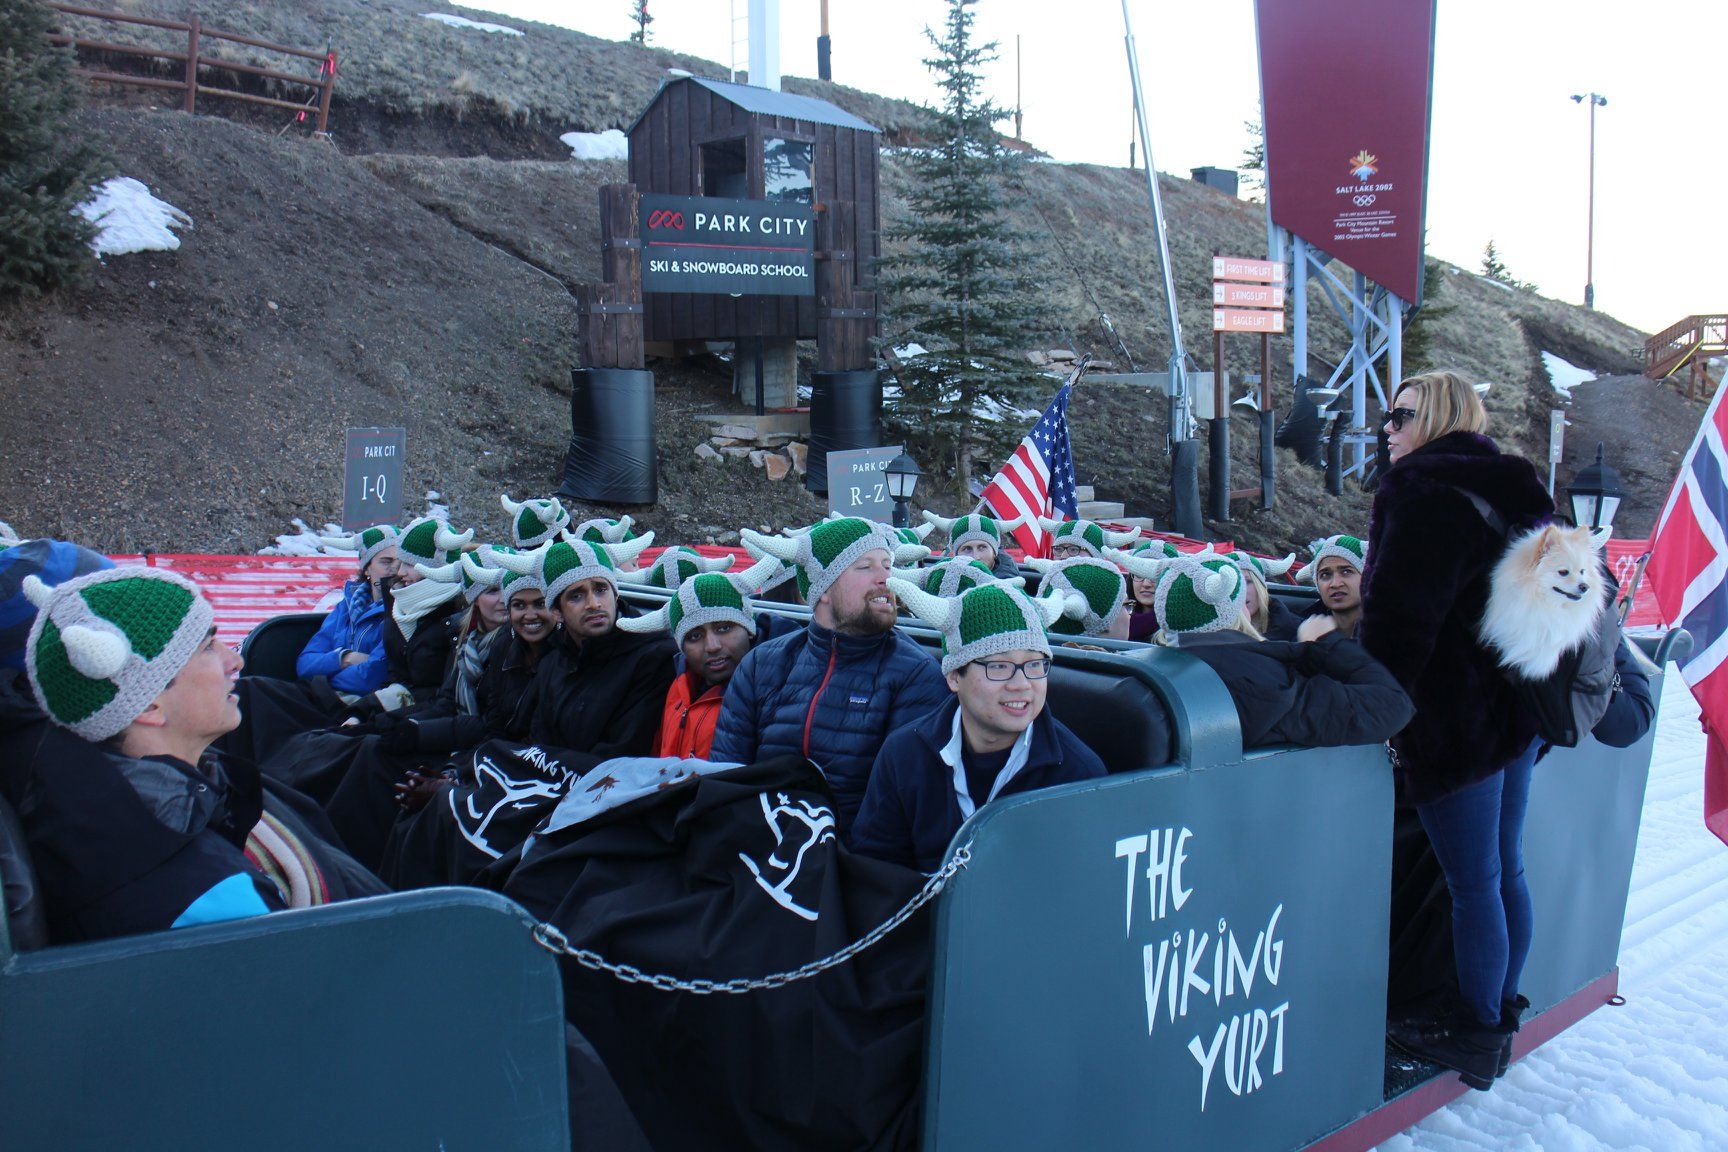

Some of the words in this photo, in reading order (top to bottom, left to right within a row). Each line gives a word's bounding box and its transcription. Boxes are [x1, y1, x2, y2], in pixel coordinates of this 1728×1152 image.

[1336, 186, 1354, 194] SALT
[1354, 184, 1374, 192] LAKE
[1375, 183, 1393, 191] 2002
[695, 213, 750, 232] PARK
[759, 217, 808, 236] CITY
[650, 260, 669, 272] SKI
[671, 261, 680, 273] &
[682, 261, 759, 275] SNOWBOARD
[760, 264, 809, 277] SCHOOL
[1227, 264, 1243, 274] FIRST
[1244, 265, 1259, 276] TIME
[1259, 266, 1271, 277] LIFT
[1236, 290, 1254, 301] KINGS
[1254, 291, 1267, 301] LIFT
[1232, 316, 1253, 326] EAGLE
[1253, 316, 1266, 327] LIFT
[364, 446, 383, 458] PARK
[852, 462, 876, 473] PARK
[362, 474, 387, 504] I-Q
[850, 483, 885, 506] R-Z
[1115, 826, 1194, 939] THE
[1187, 1001, 1289, 1113] YURT
